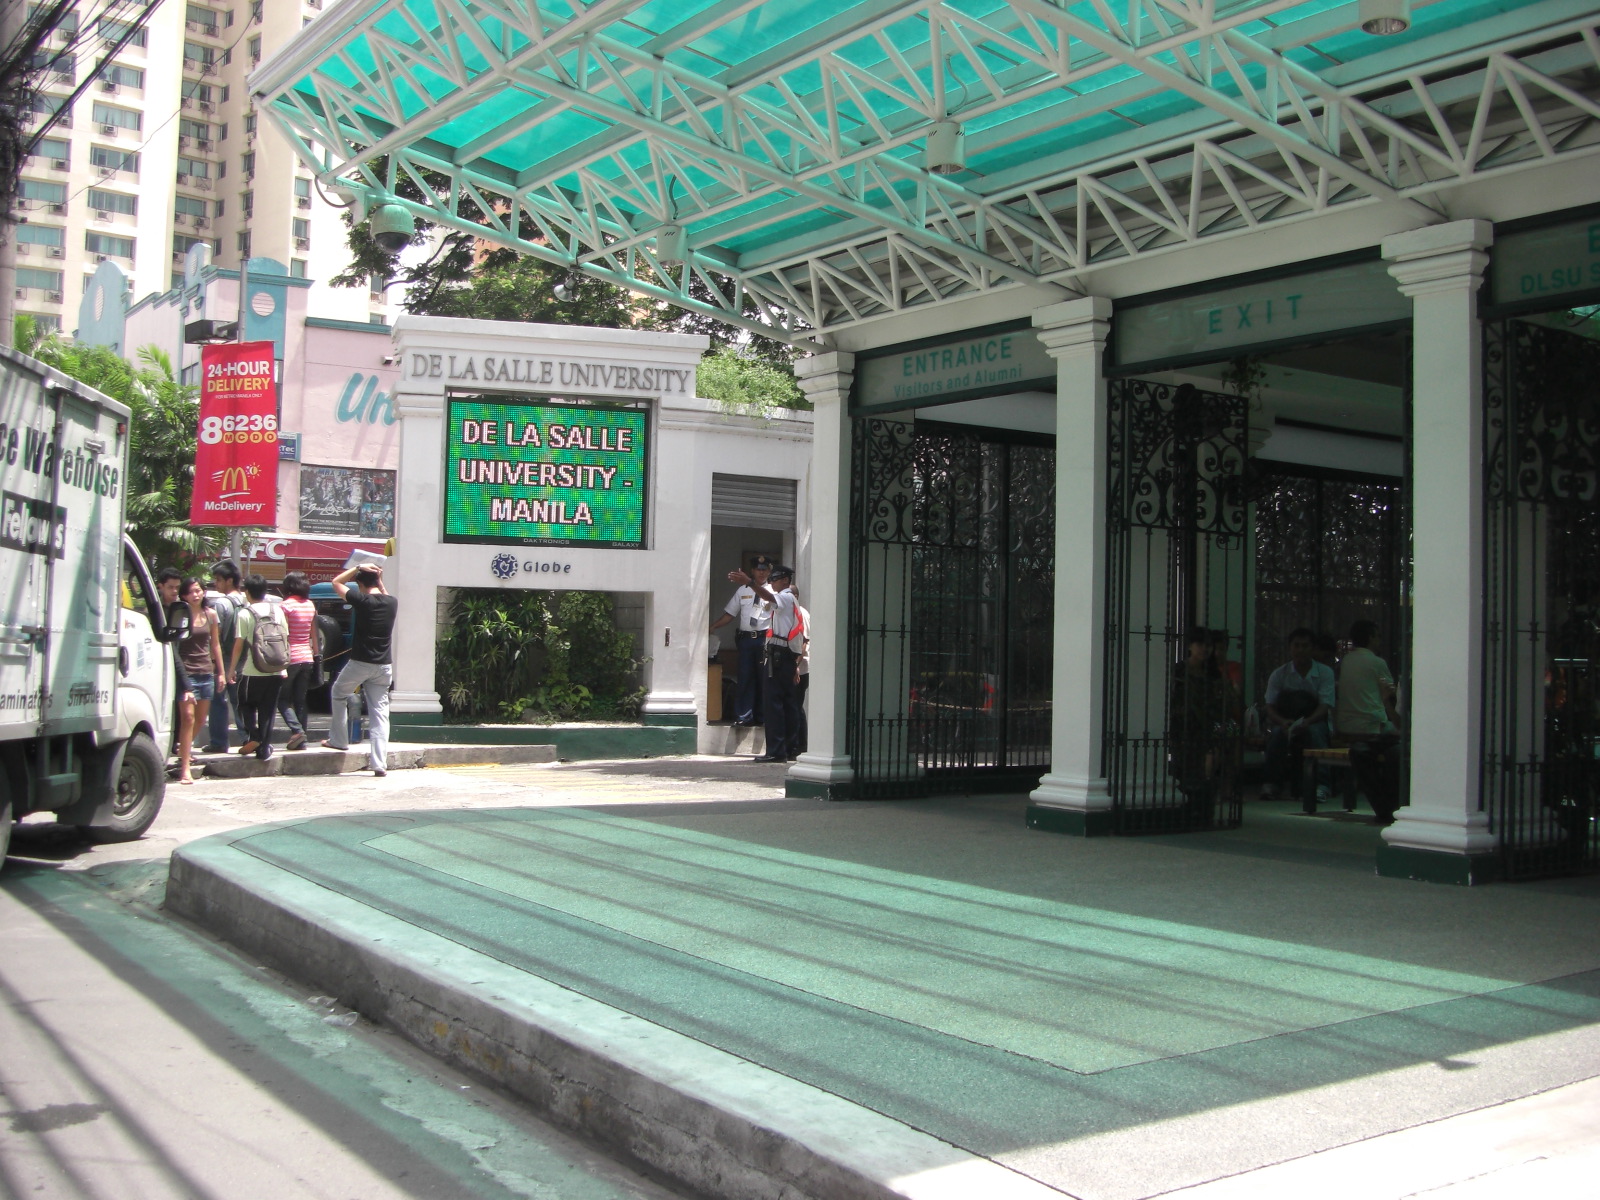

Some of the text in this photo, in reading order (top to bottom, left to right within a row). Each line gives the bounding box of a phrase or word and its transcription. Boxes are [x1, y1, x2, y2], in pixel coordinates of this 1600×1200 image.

[1520, 266, 1582, 294] DLSU
[1208, 294, 1303, 334] EXIT
[207, 361, 270, 378] 24-HOUR
[902, 337, 1013, 377] ENTRANCE
[207, 377, 271, 392] DELIVERY
[411, 353, 692, 393] DE LA SALLE UNIVERSITY
[893, 363, 1023, 398] Visitors and Alumni
[463, 420, 631, 452] DE LA SALLE
[460, 459, 616, 489] UNIVERSITY
[204, 501, 262, 513] McDelivery
[491, 498, 593, 525] MANILA
[3, 498, 65, 550] Fellows
[523, 561, 571, 574] Globe
